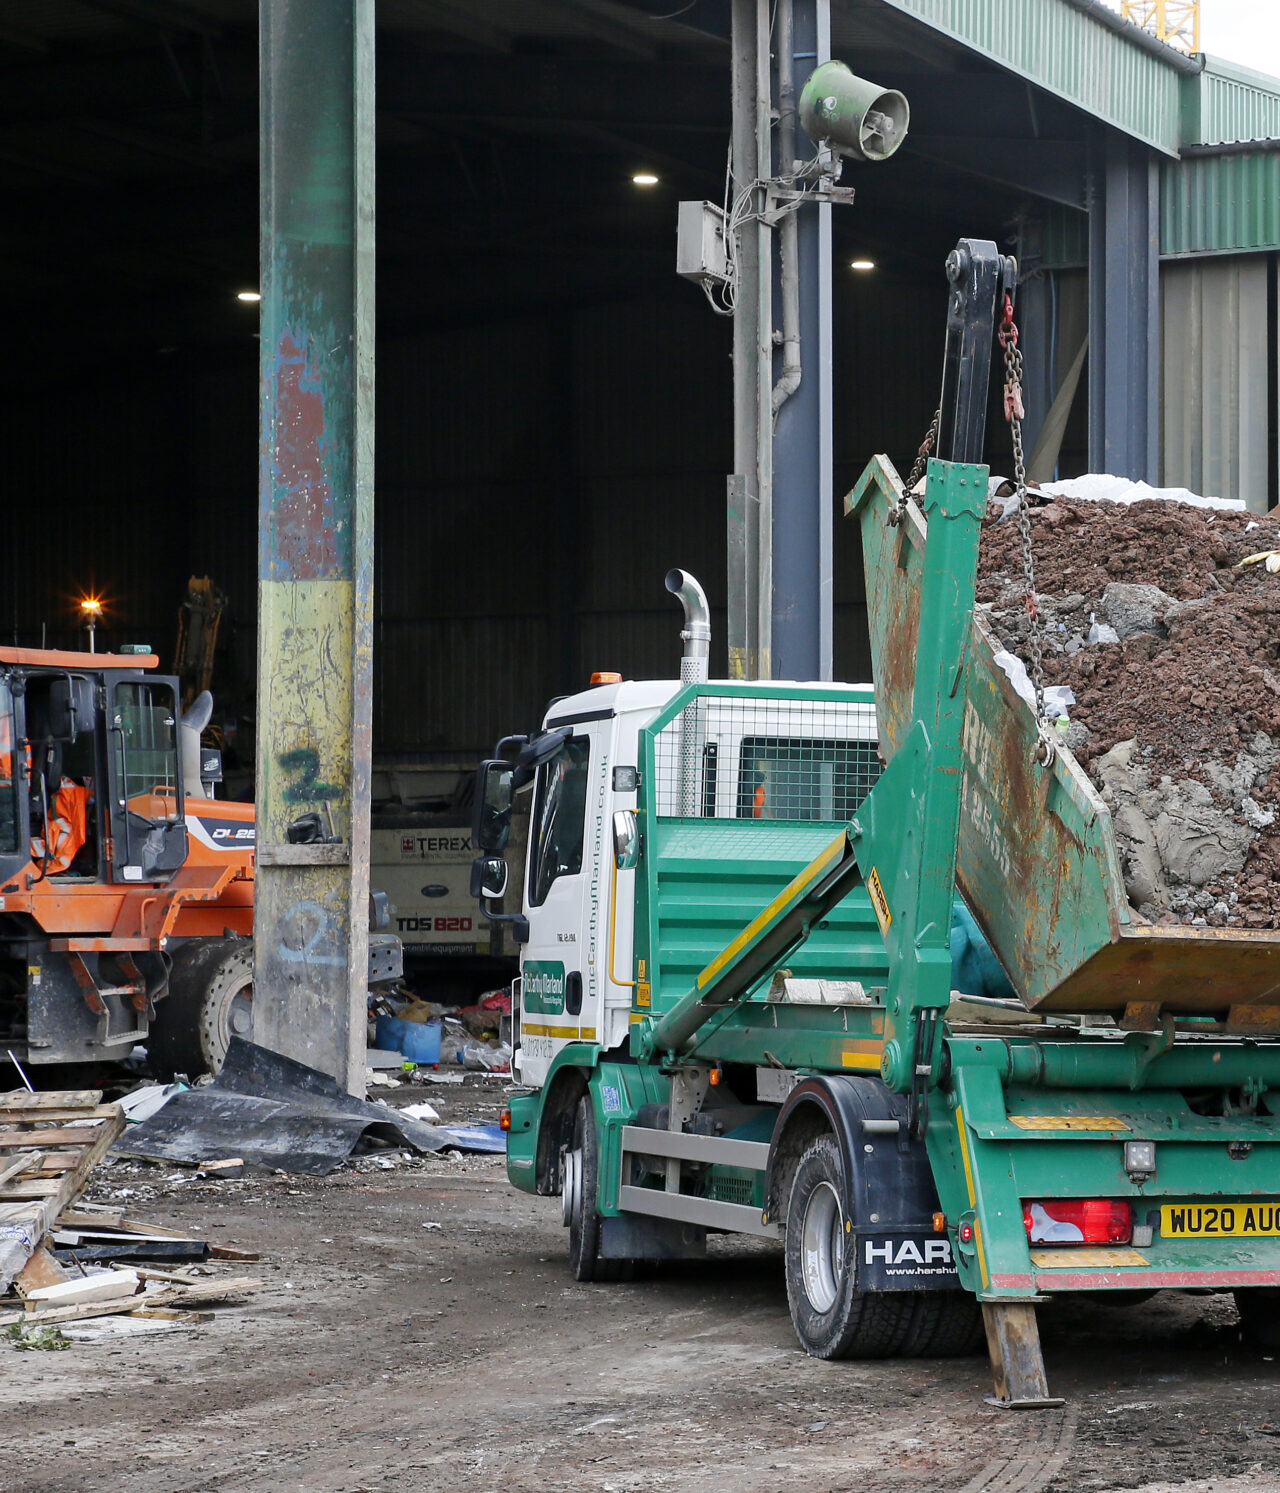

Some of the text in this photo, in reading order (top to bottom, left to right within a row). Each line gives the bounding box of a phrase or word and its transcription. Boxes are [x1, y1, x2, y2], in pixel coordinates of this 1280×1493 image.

[416, 837, 472, 851] TEREX
[396, 917, 472, 931] TDS 820
[1170, 1208, 1235, 1232] WU20
[865, 1240, 954, 1264] HAR
